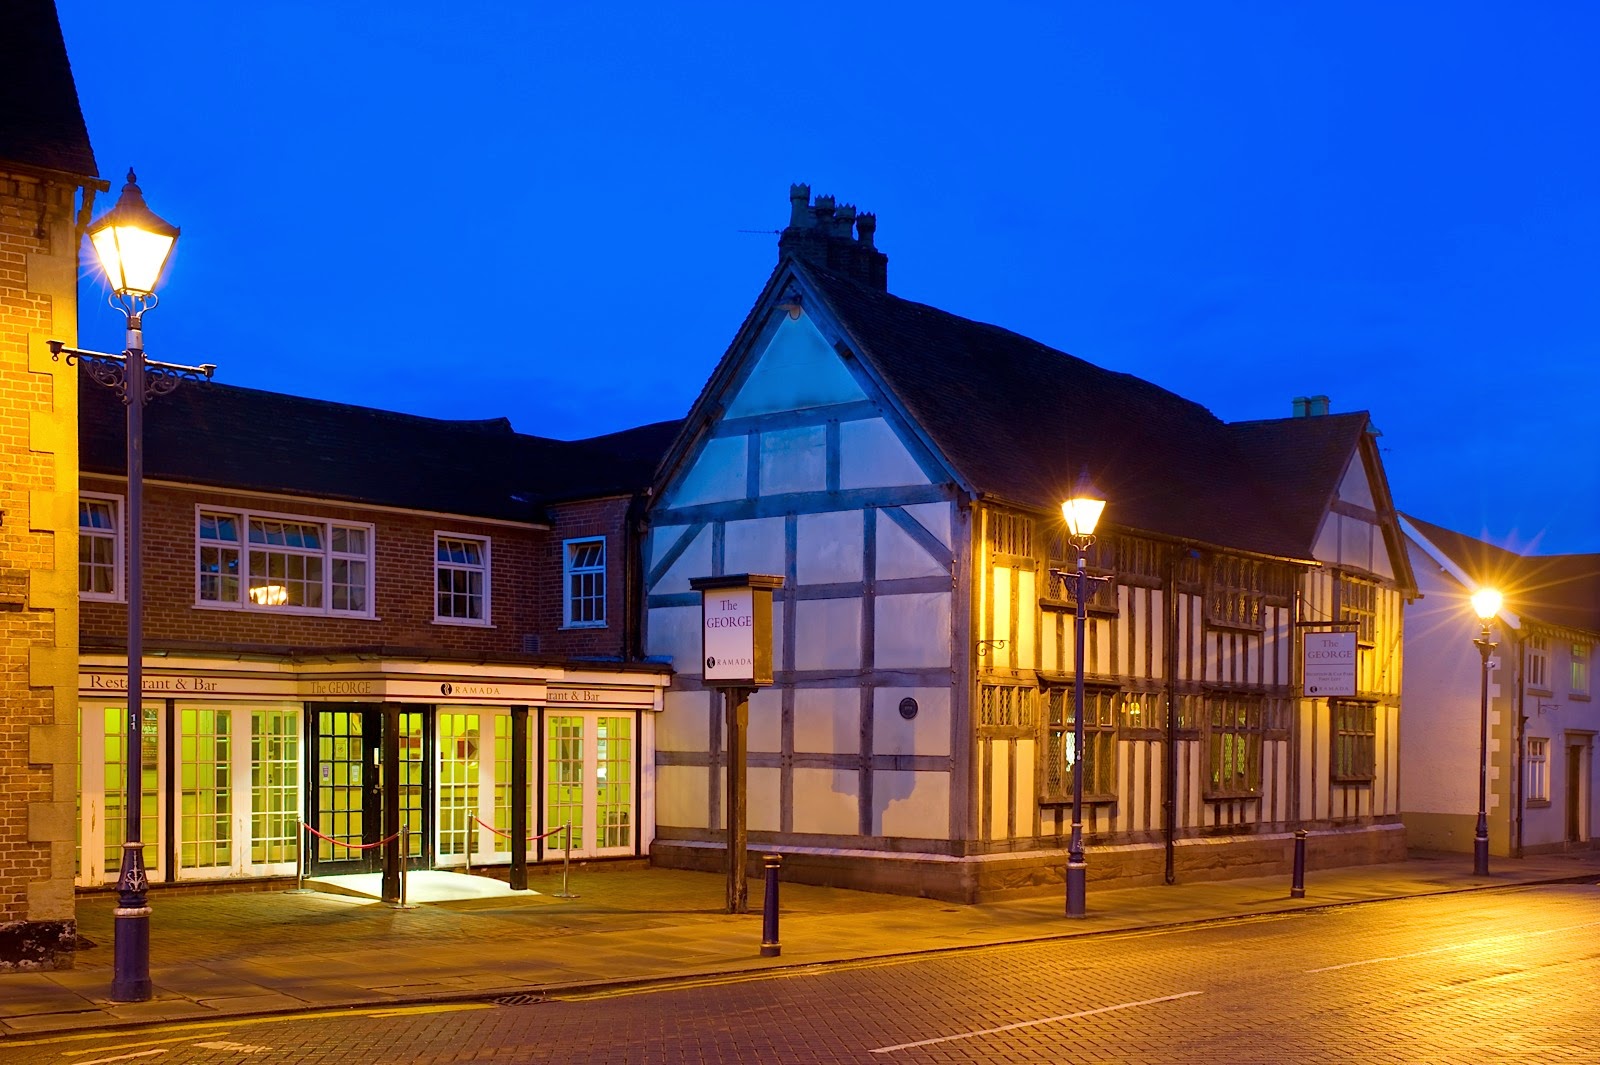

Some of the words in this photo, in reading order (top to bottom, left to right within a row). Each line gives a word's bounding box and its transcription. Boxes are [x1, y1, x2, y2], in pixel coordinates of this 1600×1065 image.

[720, 599, 738, 611] The
[706, 616, 752, 628] GEORGE
[1321, 639, 1339, 648] The
[1307, 650, 1353, 659] GEORGE
[717, 658, 752, 666] RAMADA
[90, 675, 170, 690] Restarant
[175, 678, 187, 690] &
[194, 678, 217, 691] Bar
[310, 681, 326, 694] The
[328, 681, 371, 694] GEORGE
[455, 686, 501, 695] RAMADA
[571, 691, 579, 700] &
[583, 691, 600, 701] Bar
